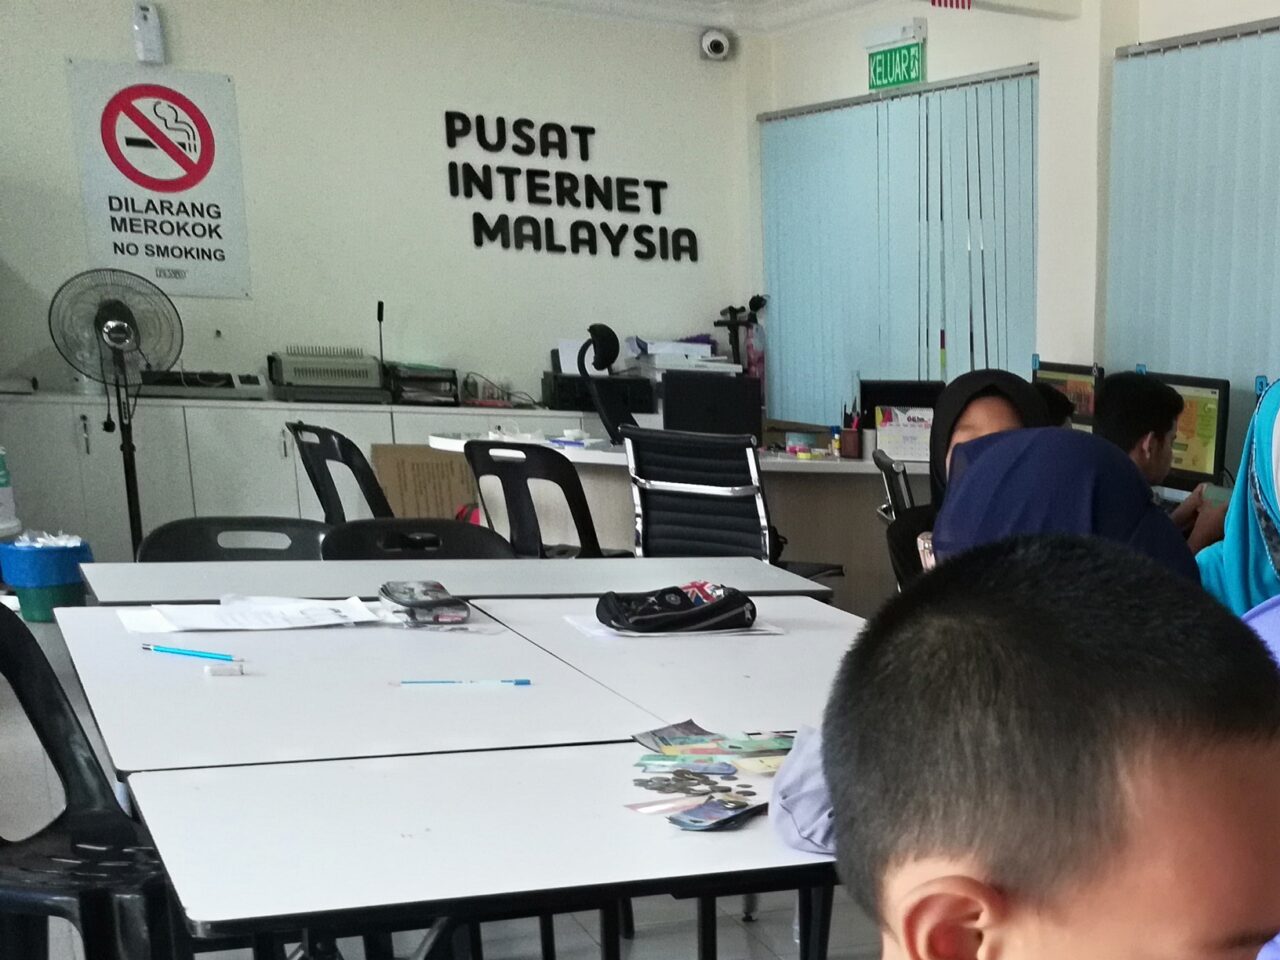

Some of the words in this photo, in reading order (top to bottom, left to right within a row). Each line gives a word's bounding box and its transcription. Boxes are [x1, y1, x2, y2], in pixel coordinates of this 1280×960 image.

[869, 49, 909, 86] KELUAR
[444, 110, 596, 162] PUSAT
[447, 161, 668, 215] INTERNET
[108, 195, 222, 220] DILARANG
[110, 215, 223, 240] MEROKOK
[472, 211, 699, 263] MALAYSIA
[113, 241, 139, 256] NO
[144, 243, 226, 262] SMOKING
